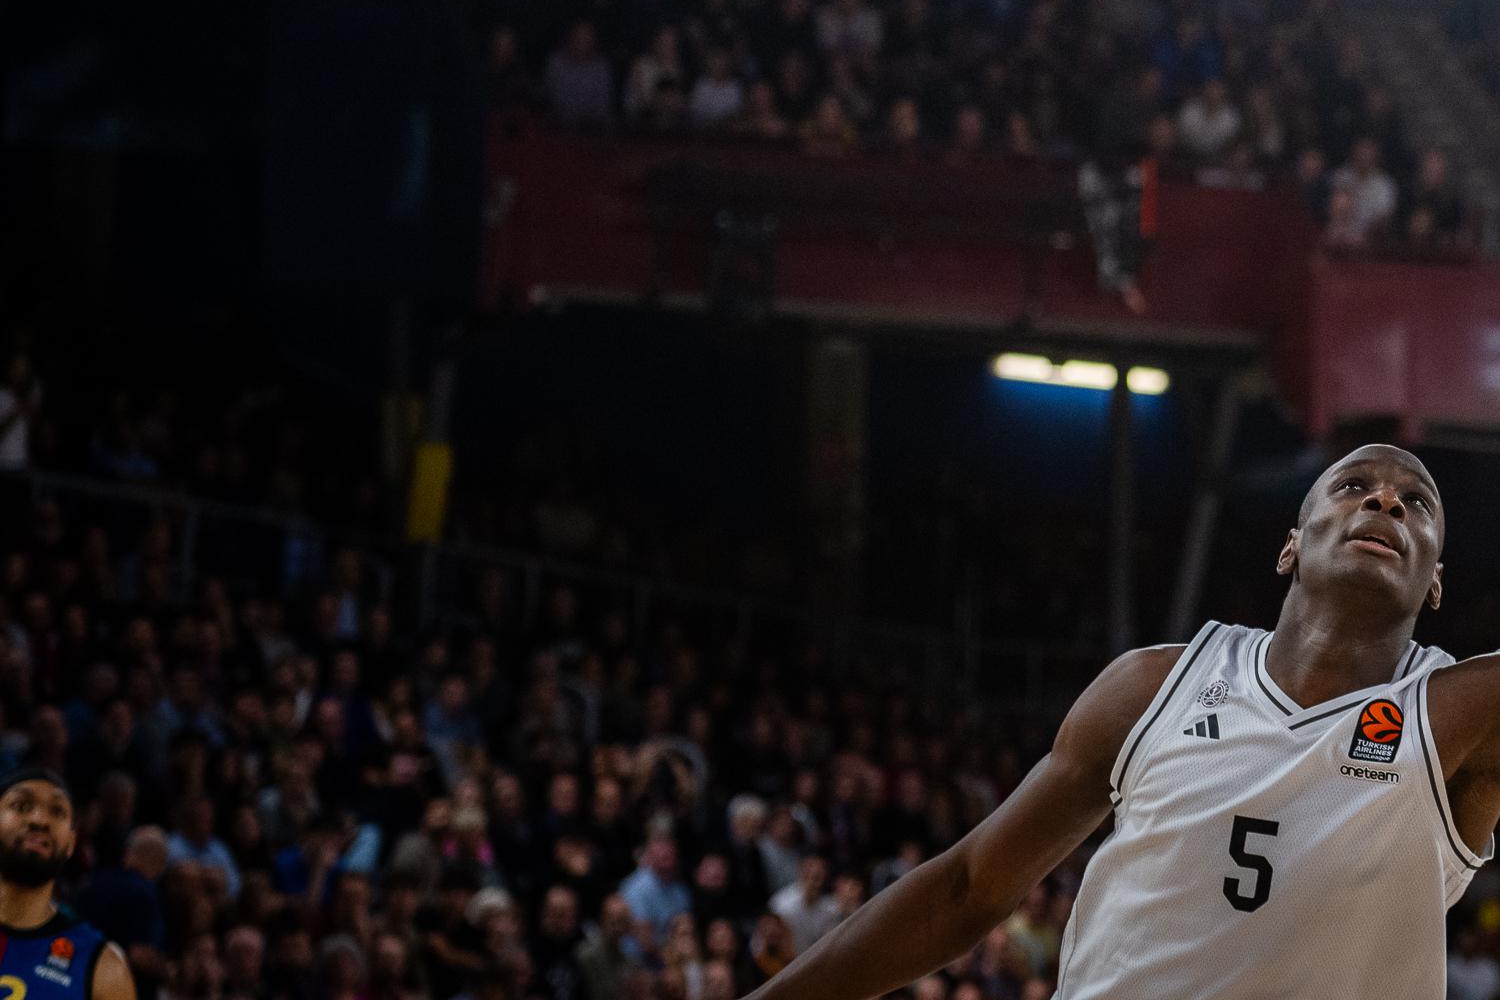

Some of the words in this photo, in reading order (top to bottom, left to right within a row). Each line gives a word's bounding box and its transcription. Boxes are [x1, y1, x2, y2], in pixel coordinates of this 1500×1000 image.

[1354, 746, 1392, 756] AIRLINES
[1357, 739, 1395, 752] TURKISH
[1352, 751, 1391, 761] EuroLeague
[1340, 765, 1399, 783] oneteam
[1223, 815, 1279, 912] 5
